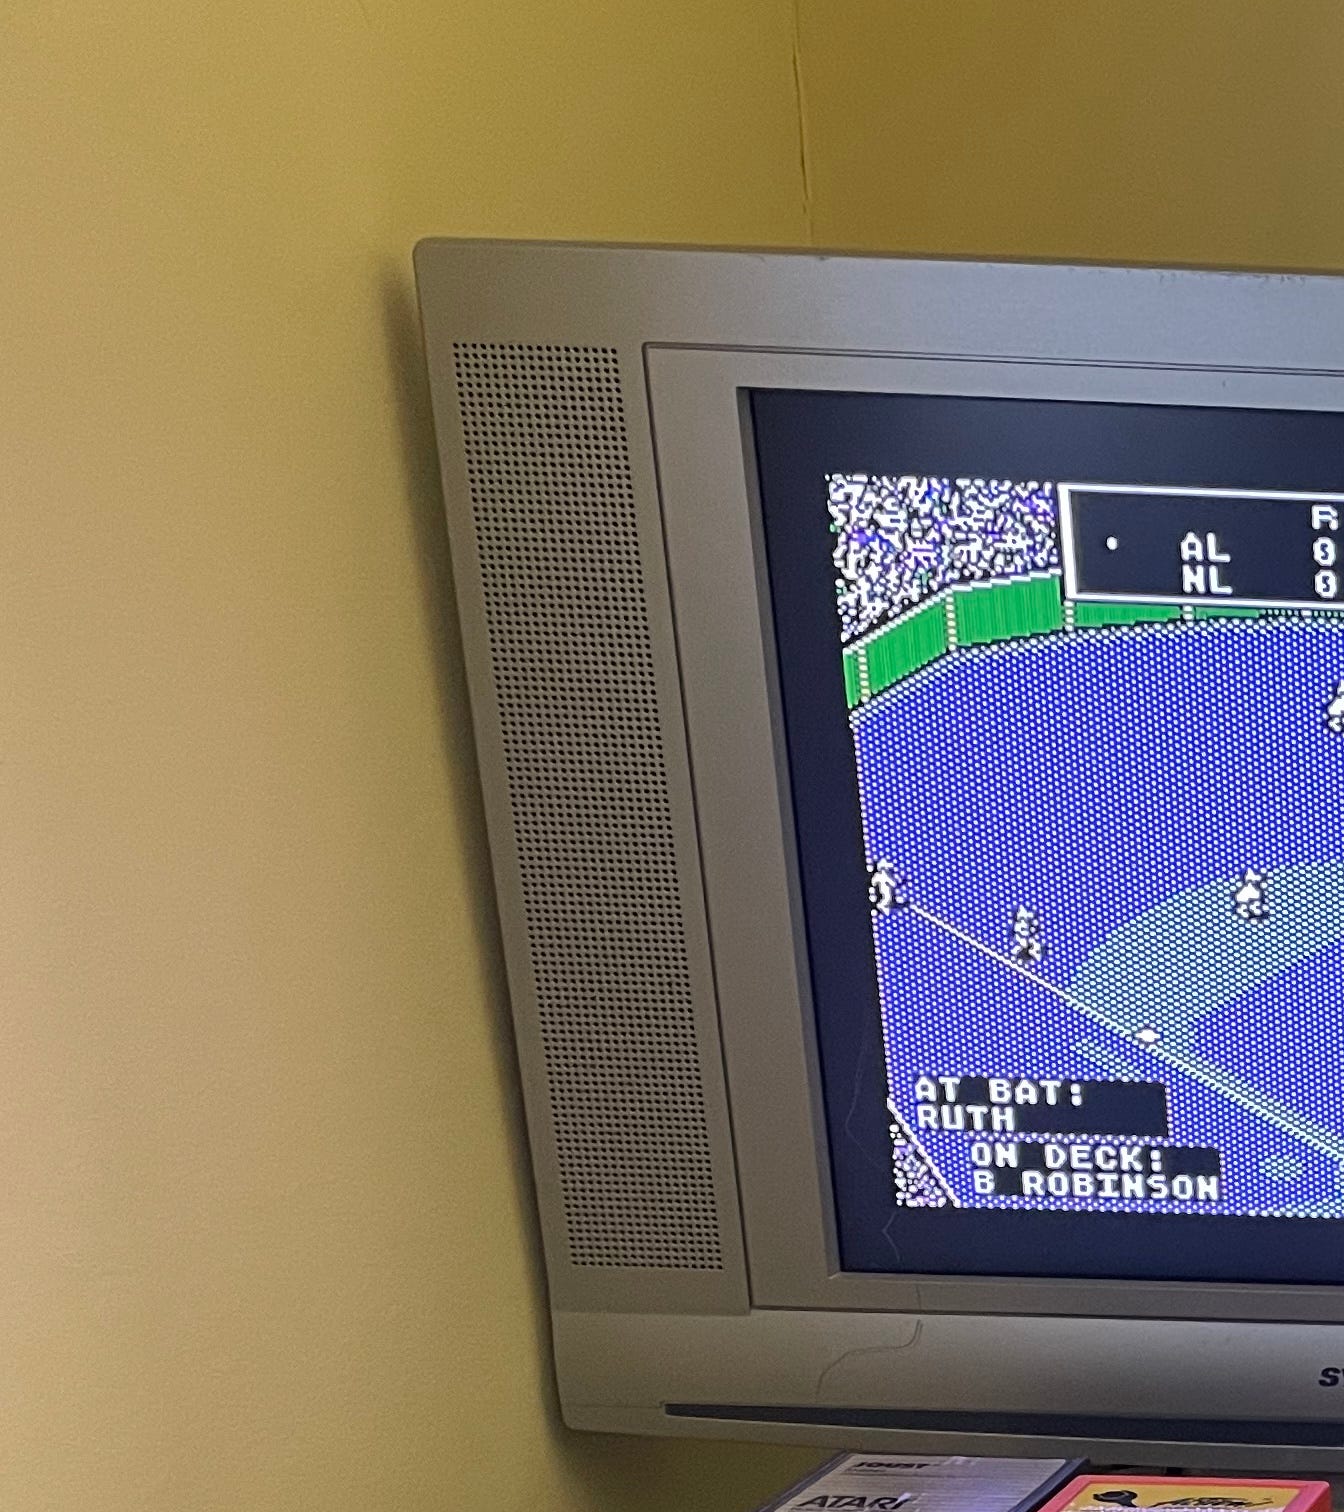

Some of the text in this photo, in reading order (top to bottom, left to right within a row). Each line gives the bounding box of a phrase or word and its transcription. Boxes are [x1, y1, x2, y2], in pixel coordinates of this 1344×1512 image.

[1311, 505, 1339, 530] R
[1181, 532, 1230, 563] AL
[1313, 537, 1336, 567] 0
[1182, 565, 1232, 595] NL
[1315, 569, 1337, 599] 0
[914, 1076, 1082, 1107] AT BAT:
[917, 1104, 1015, 1132] RUTH
[970, 1141, 1163, 1173] ON DECK:
[973, 1170, 1220, 1201] B ROBINSON
[797, 1495, 910, 1509] ATARI
